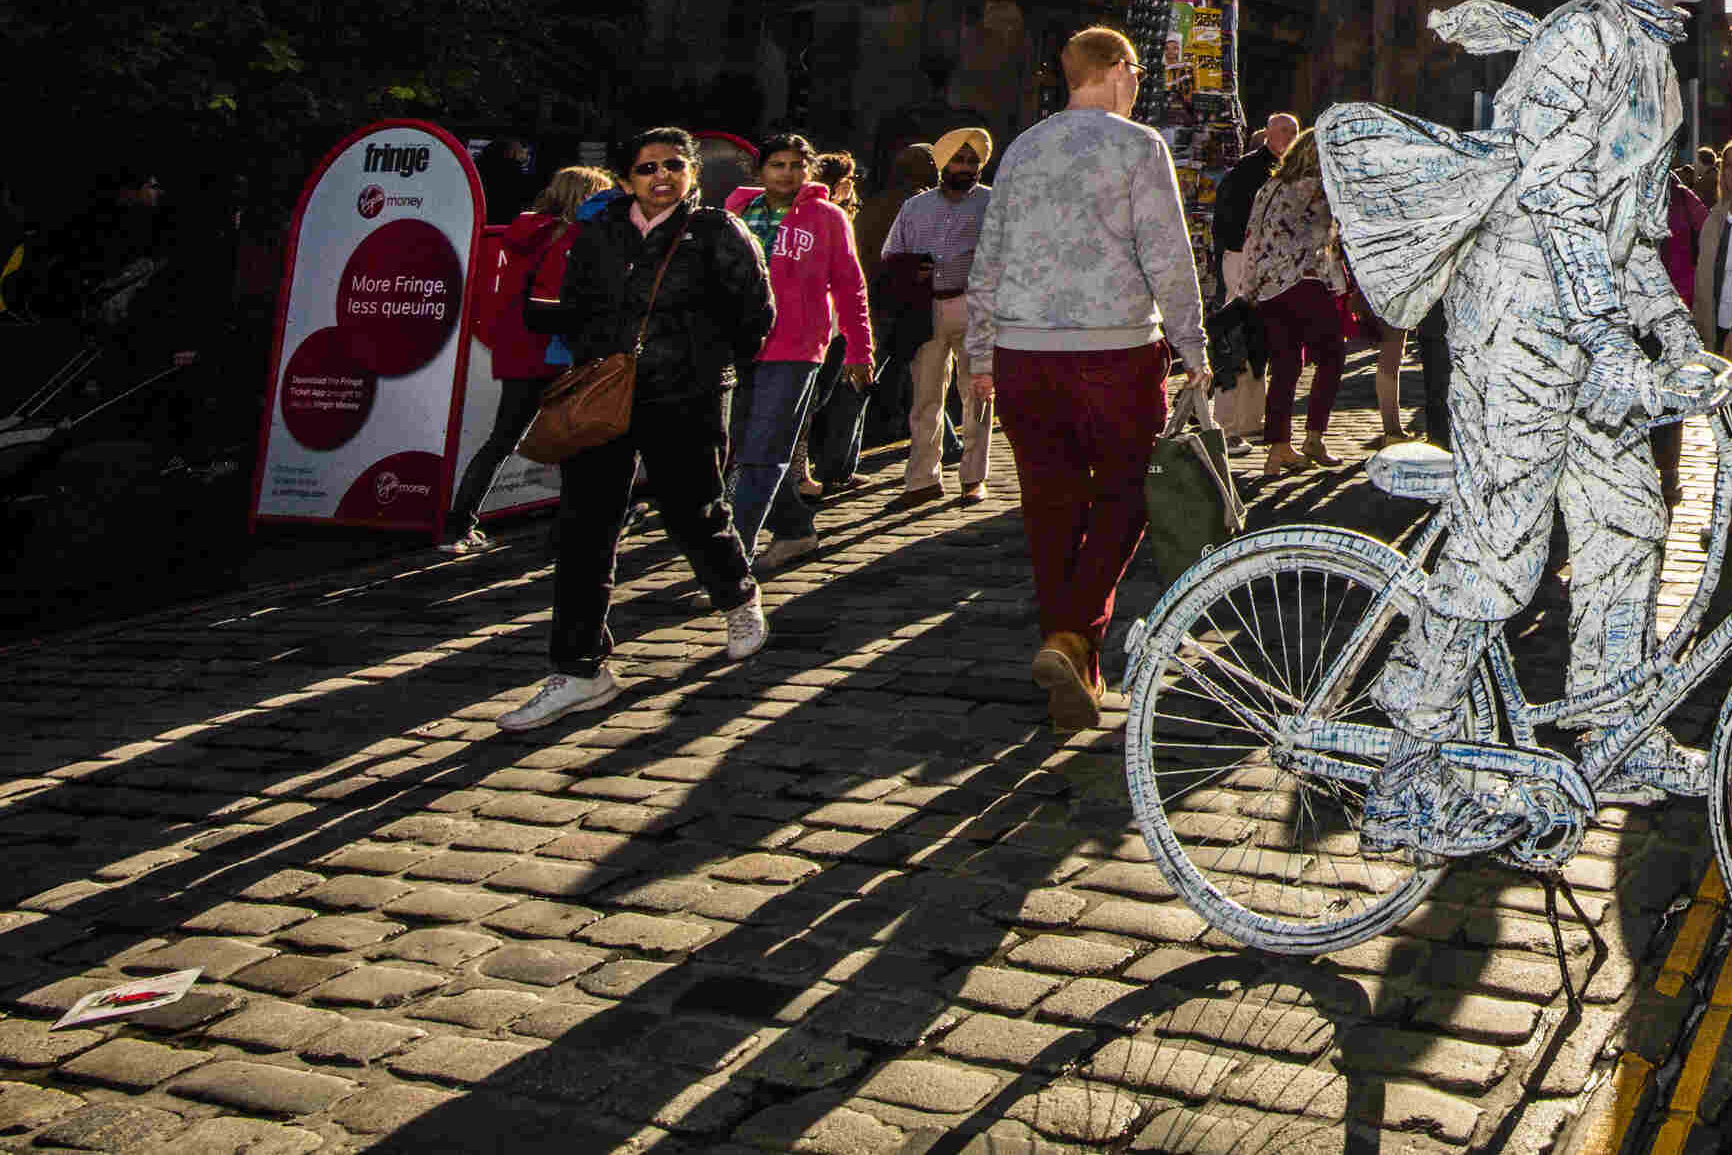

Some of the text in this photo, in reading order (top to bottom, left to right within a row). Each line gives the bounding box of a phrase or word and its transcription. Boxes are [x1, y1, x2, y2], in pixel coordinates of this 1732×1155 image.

[364, 143, 430, 178] fringe
[386, 196, 424, 210] money
[351, 275, 448, 298] More Fringe,
[347, 297, 446, 321] less queuing
